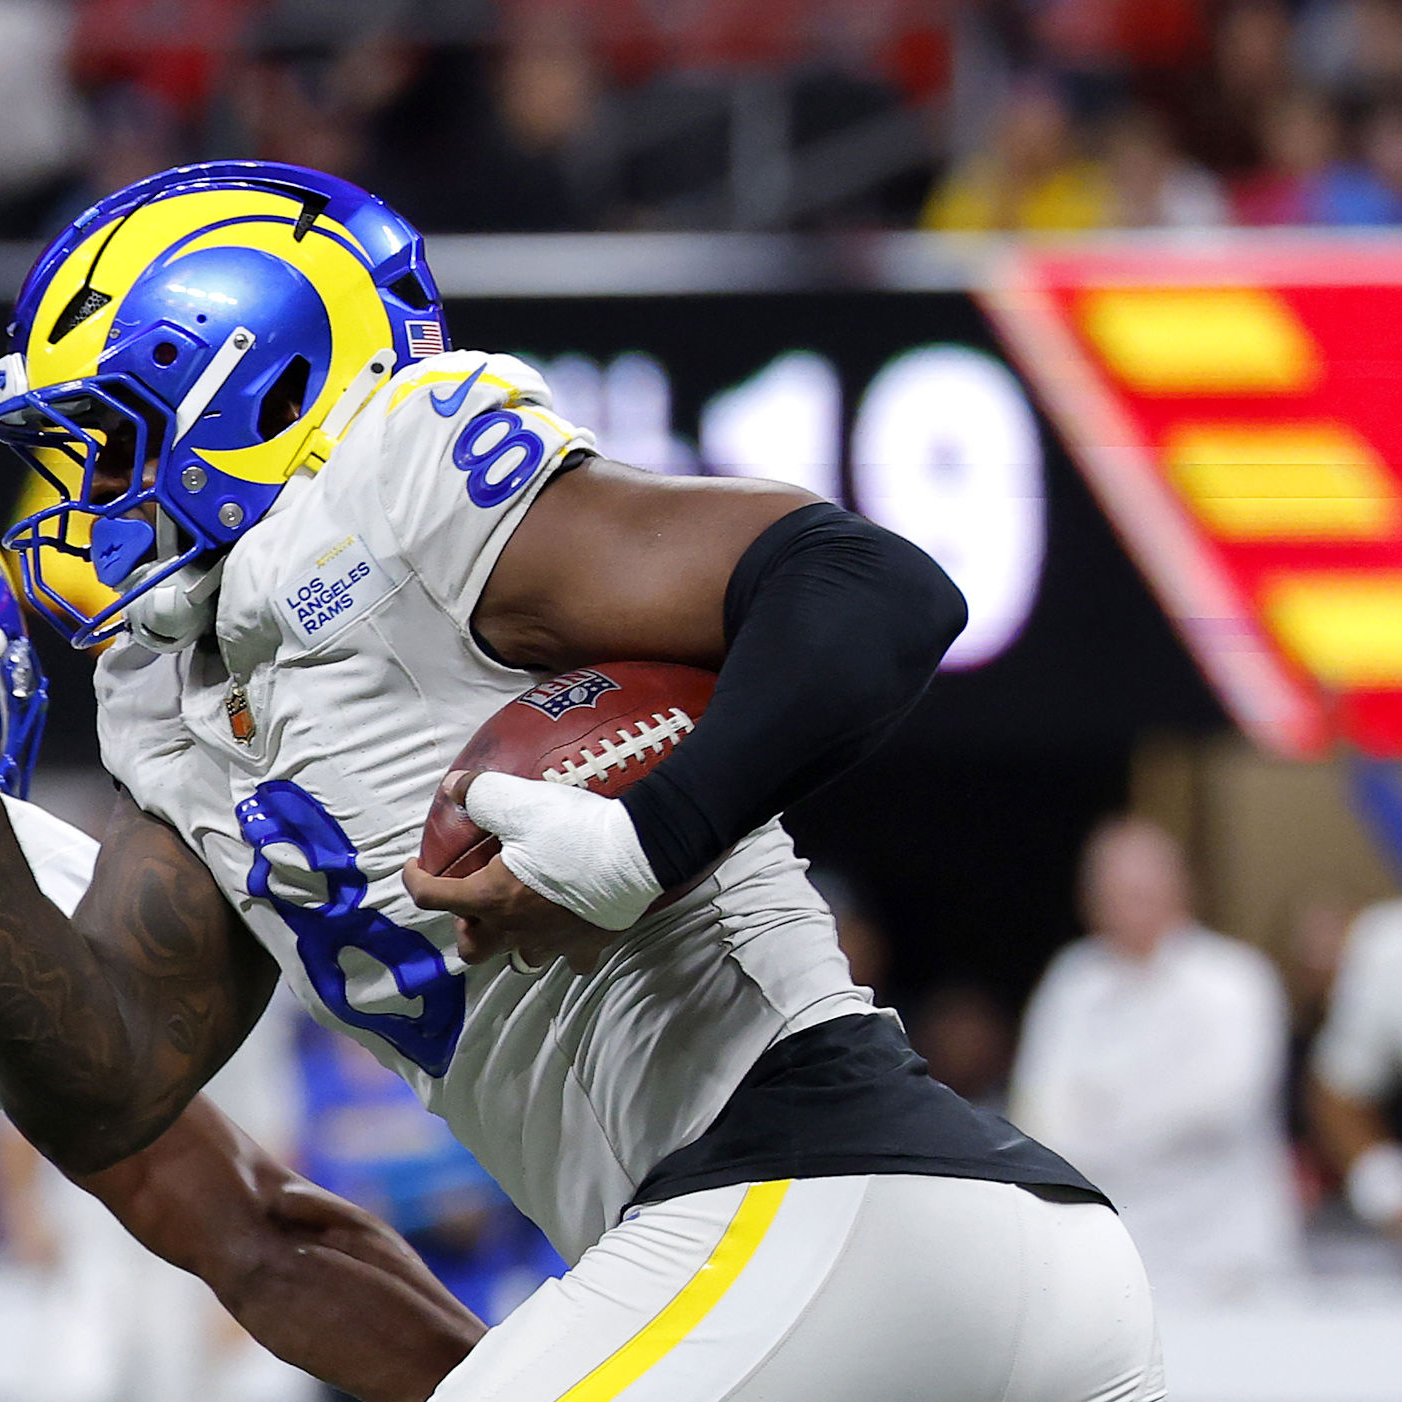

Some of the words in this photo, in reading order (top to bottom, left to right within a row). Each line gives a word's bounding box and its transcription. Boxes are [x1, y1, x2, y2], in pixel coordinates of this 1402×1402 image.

[452, 410, 544, 508] 8
[285, 577, 325, 610] LOS
[297, 561, 371, 622] ANGELES
[303, 593, 354, 635] RAMS
[234, 778, 467, 1079] 8
